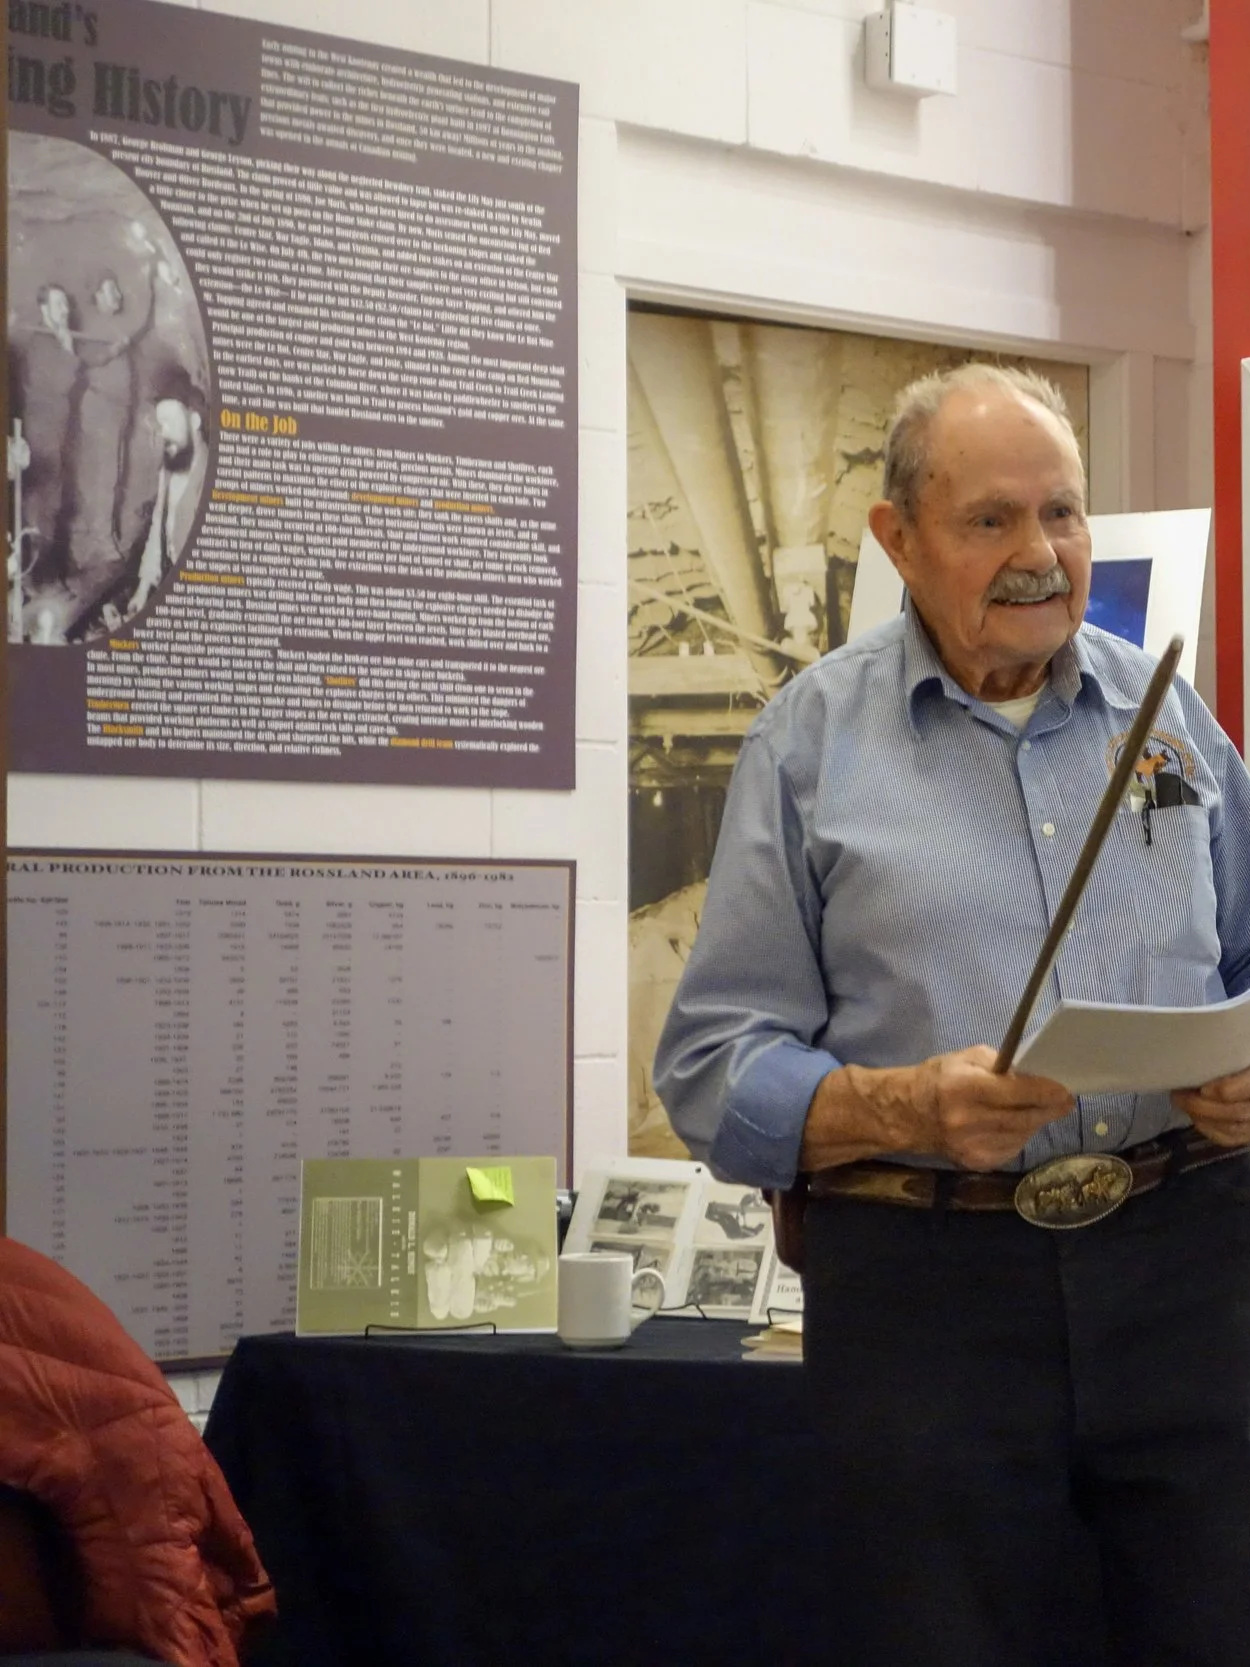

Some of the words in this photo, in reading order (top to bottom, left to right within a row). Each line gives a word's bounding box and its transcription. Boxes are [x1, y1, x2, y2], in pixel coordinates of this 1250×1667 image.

[93, 62, 252, 146] History
[220, 408, 241, 429] On
[245, 412, 268, 431] the
[273, 415, 297, 435] Job
[50, 863, 184, 875] PRODUCTION
[188, 865, 242, 877] FROM
[244, 867, 285, 878] THE
[289, 867, 386, 879] ROSSLAND
